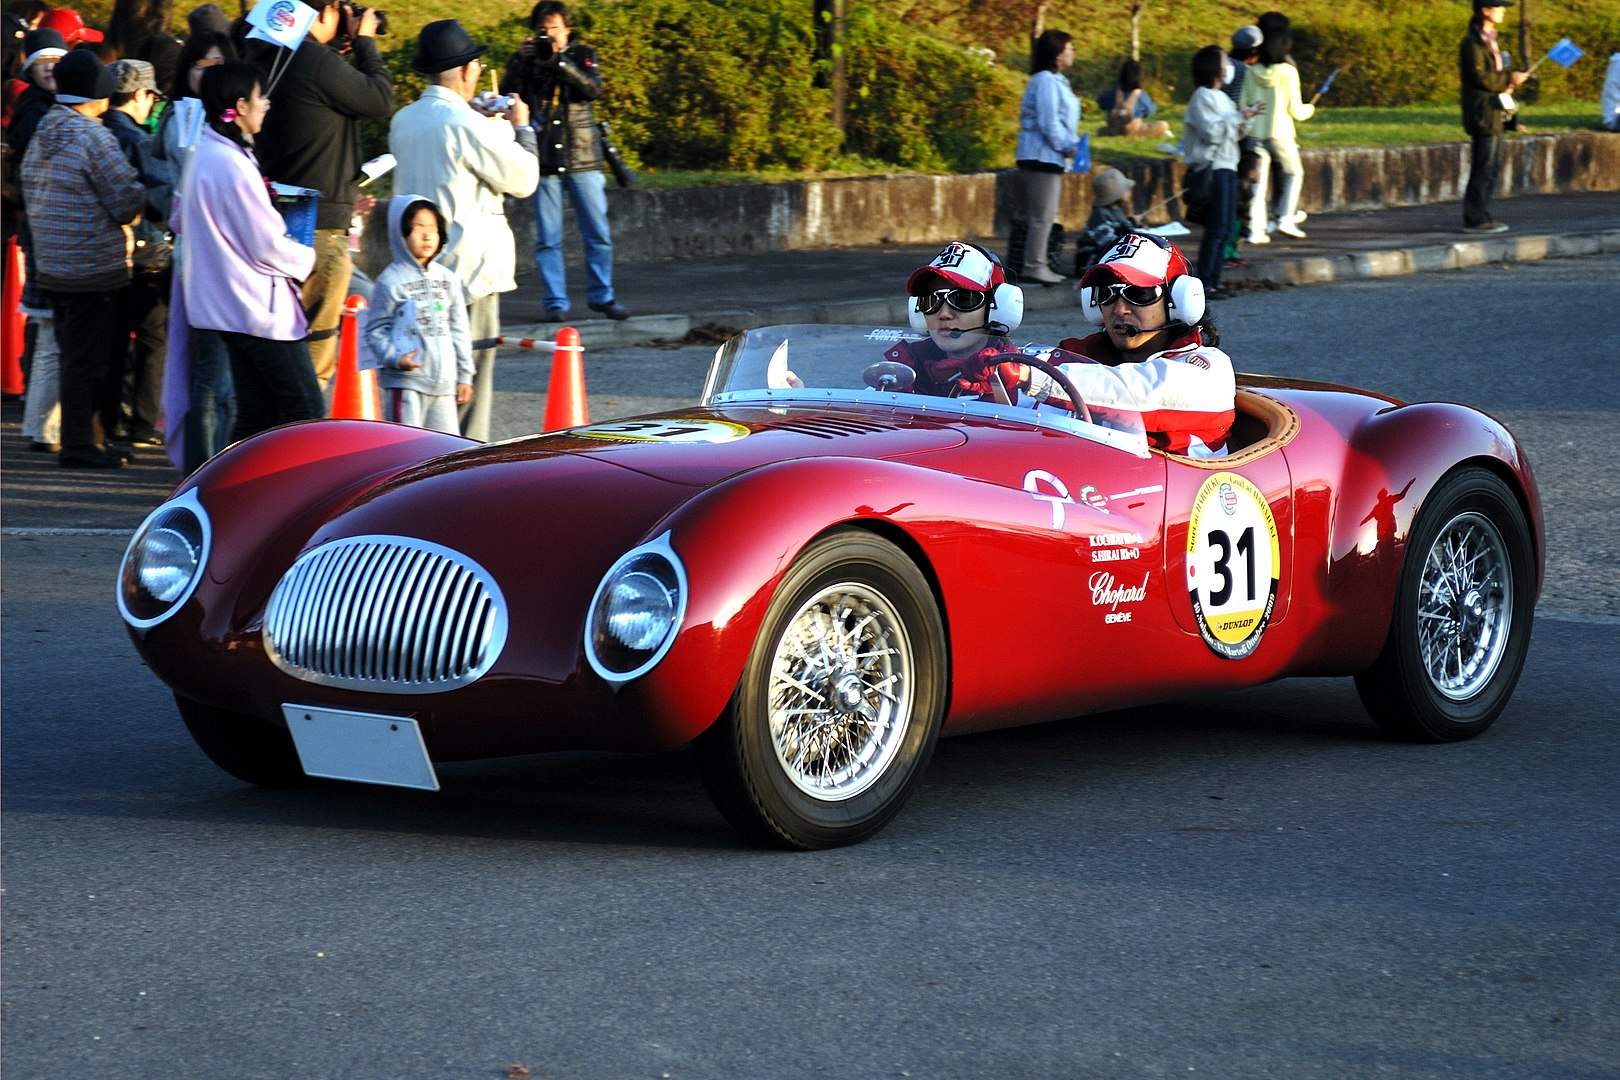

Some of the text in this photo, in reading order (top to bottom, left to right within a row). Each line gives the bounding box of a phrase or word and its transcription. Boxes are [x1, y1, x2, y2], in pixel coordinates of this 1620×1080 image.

[1207, 526, 1257, 607] 31
[1088, 570, 1151, 612] Chopard
[1222, 618, 1254, 631] DUNLOP
